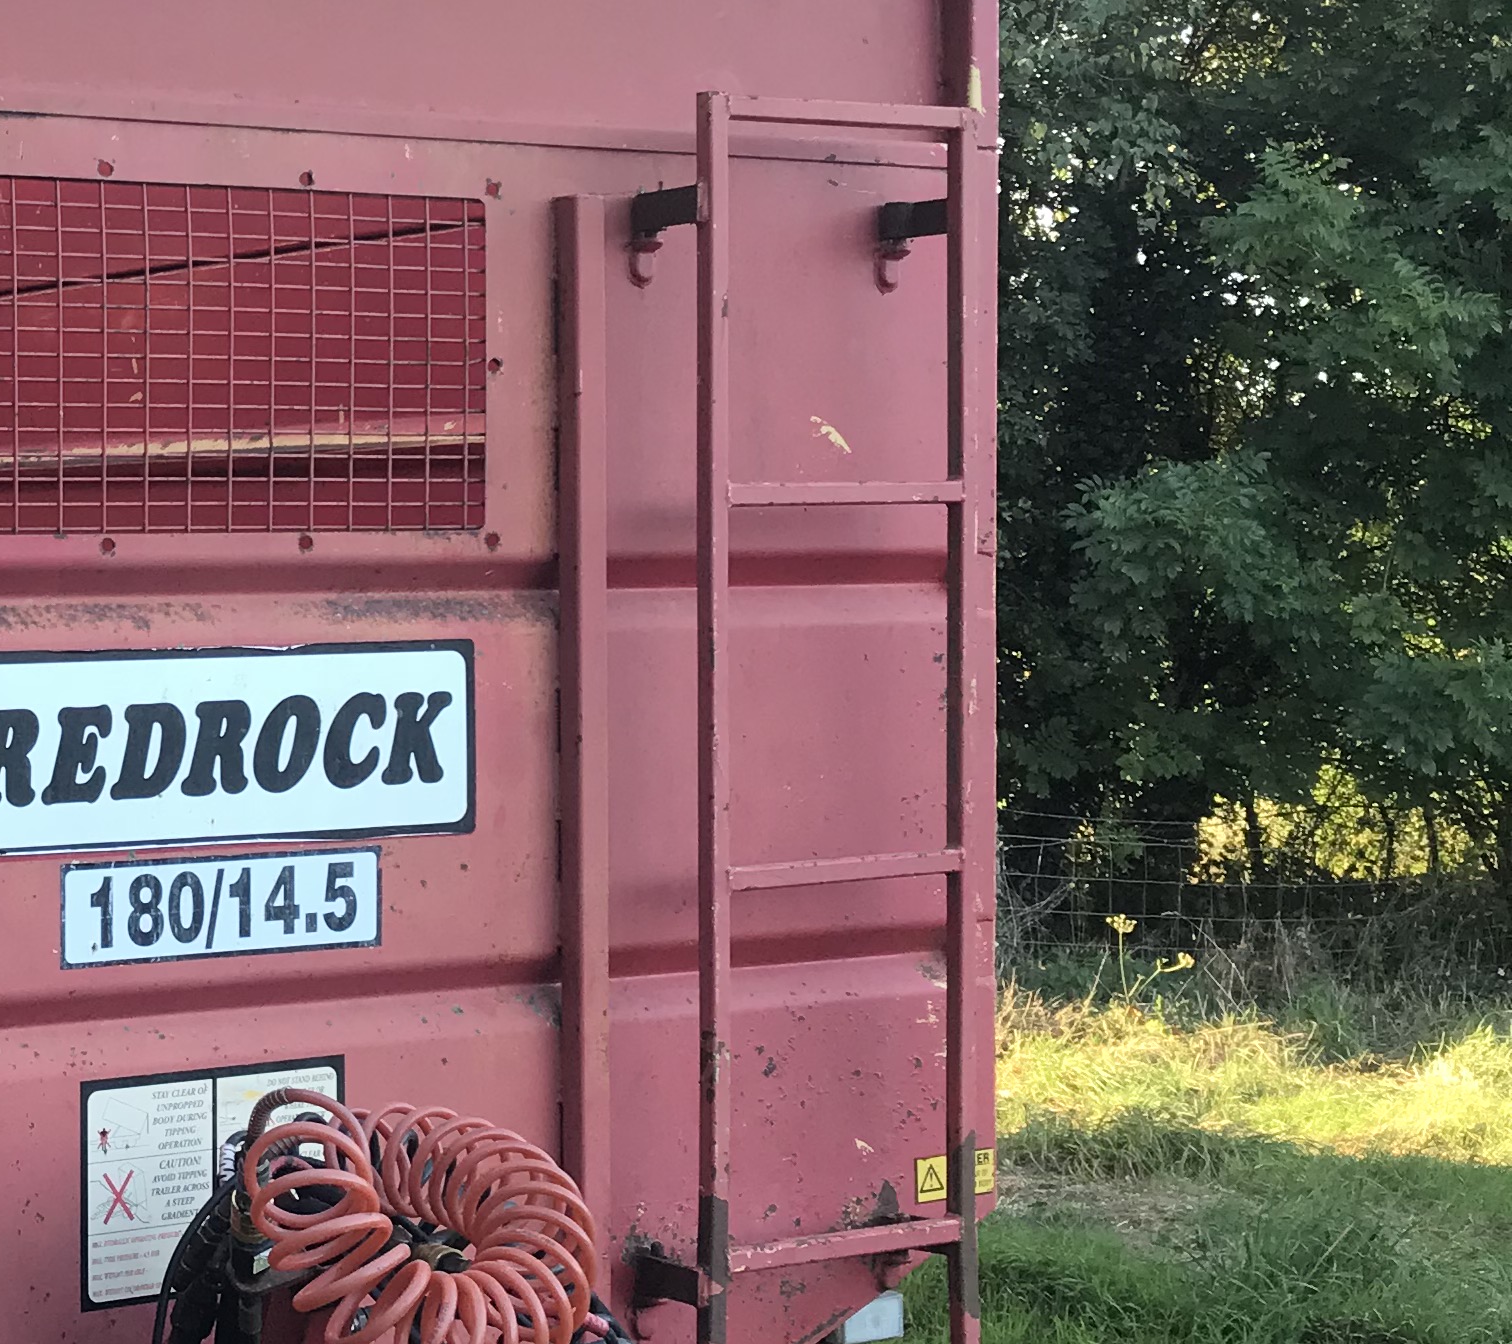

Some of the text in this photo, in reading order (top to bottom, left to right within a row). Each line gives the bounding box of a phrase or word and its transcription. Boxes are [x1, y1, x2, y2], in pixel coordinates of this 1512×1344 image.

[90, 862, 357, 950] 180/14.5
[152, 1090, 169, 1099] STAY
[171, 1087, 196, 1097] CLEAR
[156, 1099, 204, 1112] UNPROPPED
[152, 1112, 208, 1125] BODY DURING
[165, 1126, 196, 1137] TIPPING
[158, 1138, 202, 1150] OPERATION
[159, 1156, 202, 1169] CAUTION!
[152, 1169, 208, 1183] AVOID TIPPING
[151, 1181, 210, 1196] TRAILER ACROSS
[172, 1196, 195, 1206] STEEP
[161, 1208, 199, 1220] GRADIENT
